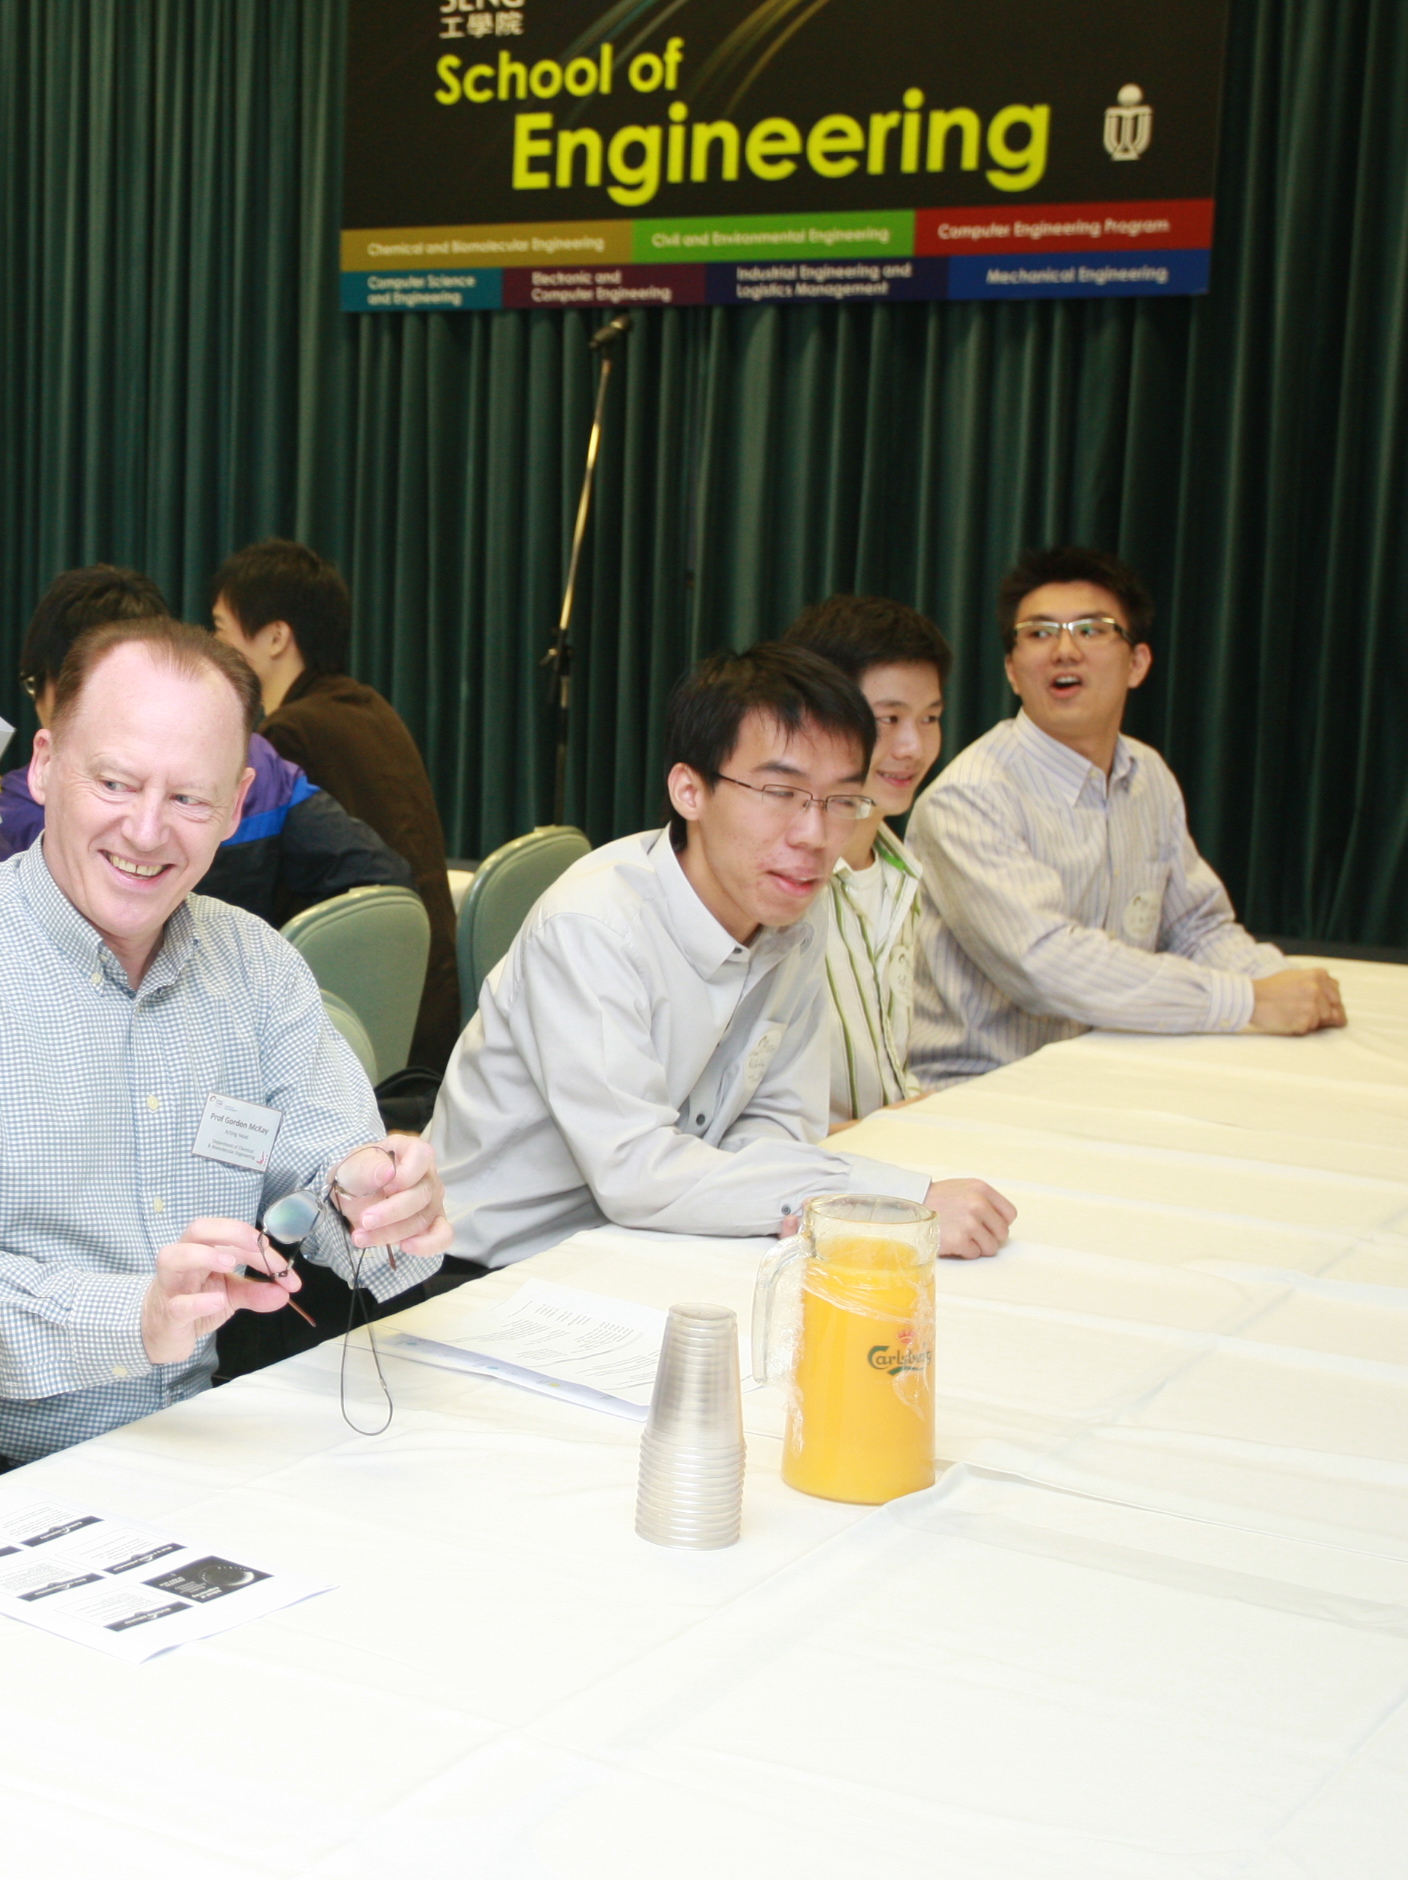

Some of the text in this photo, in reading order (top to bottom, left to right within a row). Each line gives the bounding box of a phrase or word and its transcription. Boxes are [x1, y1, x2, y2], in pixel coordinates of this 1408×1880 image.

[439, 10, 524, 38] 工學院
[435, 37, 685, 105] School of
[512, 87, 1051, 207] Engineering
[652, 226, 890, 248] Civil and Environmental Engineering
[938, 217, 1170, 241] Computer Engineering Program
[367, 235, 605, 256] Chemical and Biomolecular Engineering
[367, 273, 476, 291] Computer Science
[531, 269, 622, 286] Electronic and
[736, 261, 912, 283] Industrial Engineering and
[985, 263, 1169, 286] Mechanical Engineering
[367, 290, 462, 307] and Engineering
[531, 285, 673, 305] Computer Engineering
[736, 280, 889, 301] Logistics Management
[210, 1112, 269, 1136] Prof Gordon McKay
